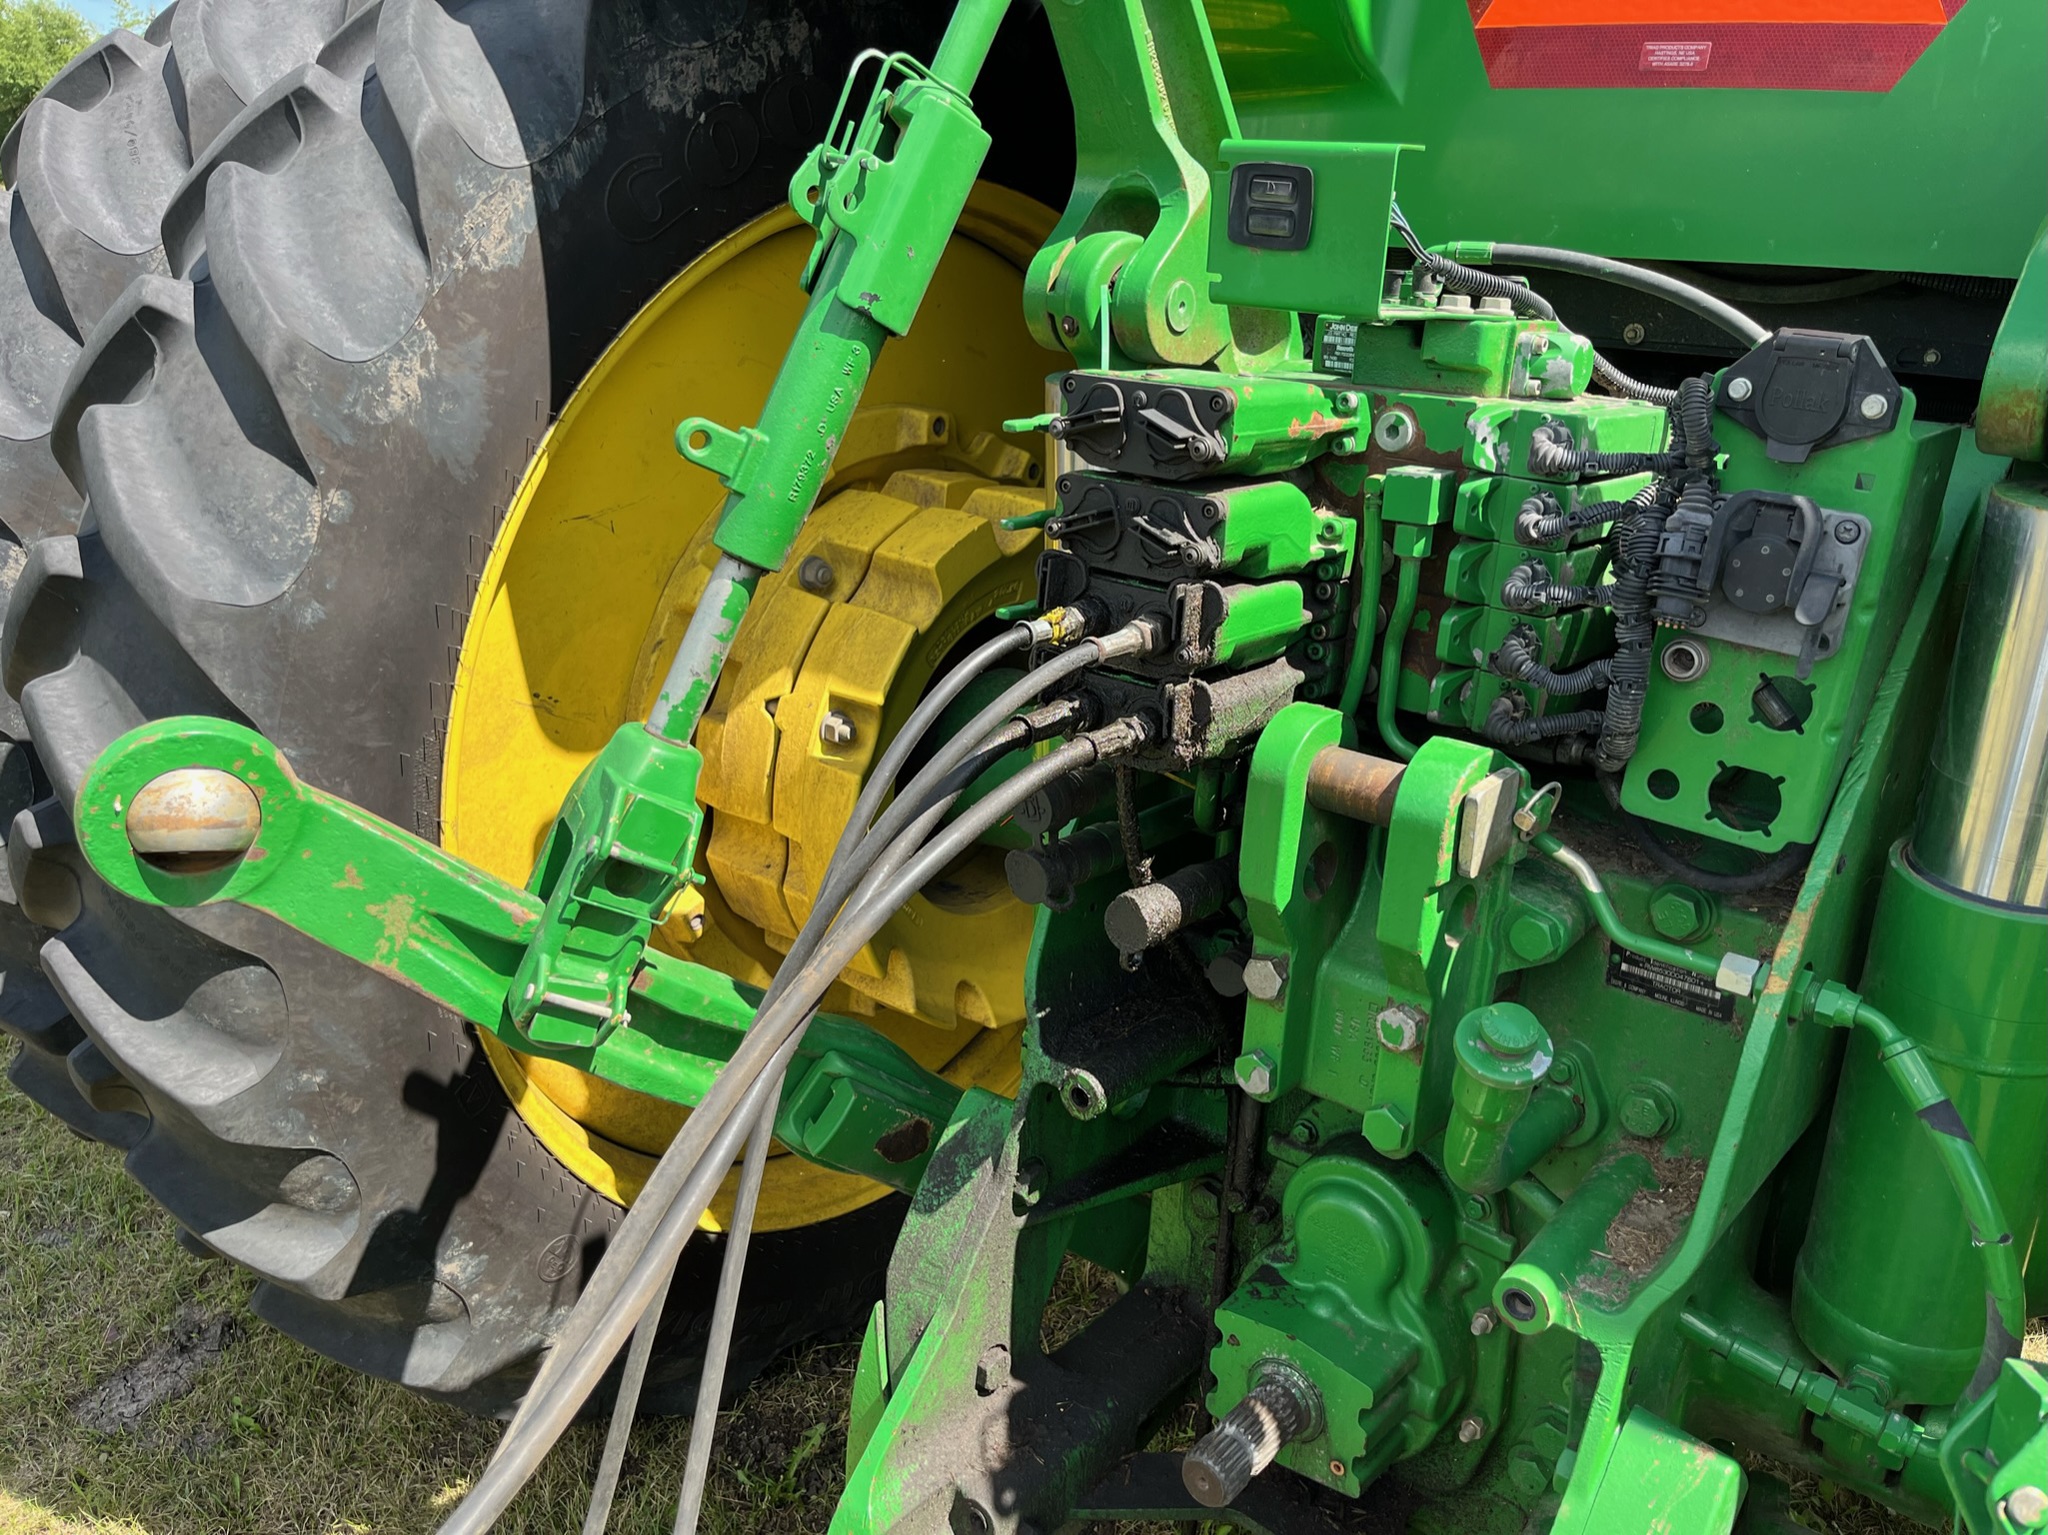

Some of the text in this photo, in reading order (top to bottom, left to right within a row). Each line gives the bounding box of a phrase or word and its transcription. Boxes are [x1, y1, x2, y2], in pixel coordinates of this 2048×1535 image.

[826, 386, 844, 414] USA
[1768, 386, 1830, 414] Pollak
[1653, 981, 1681, 994] TRACTOR
[1713, 1010, 1722, 1018] USA
[1348, 1016, 1361, 1041] USA
